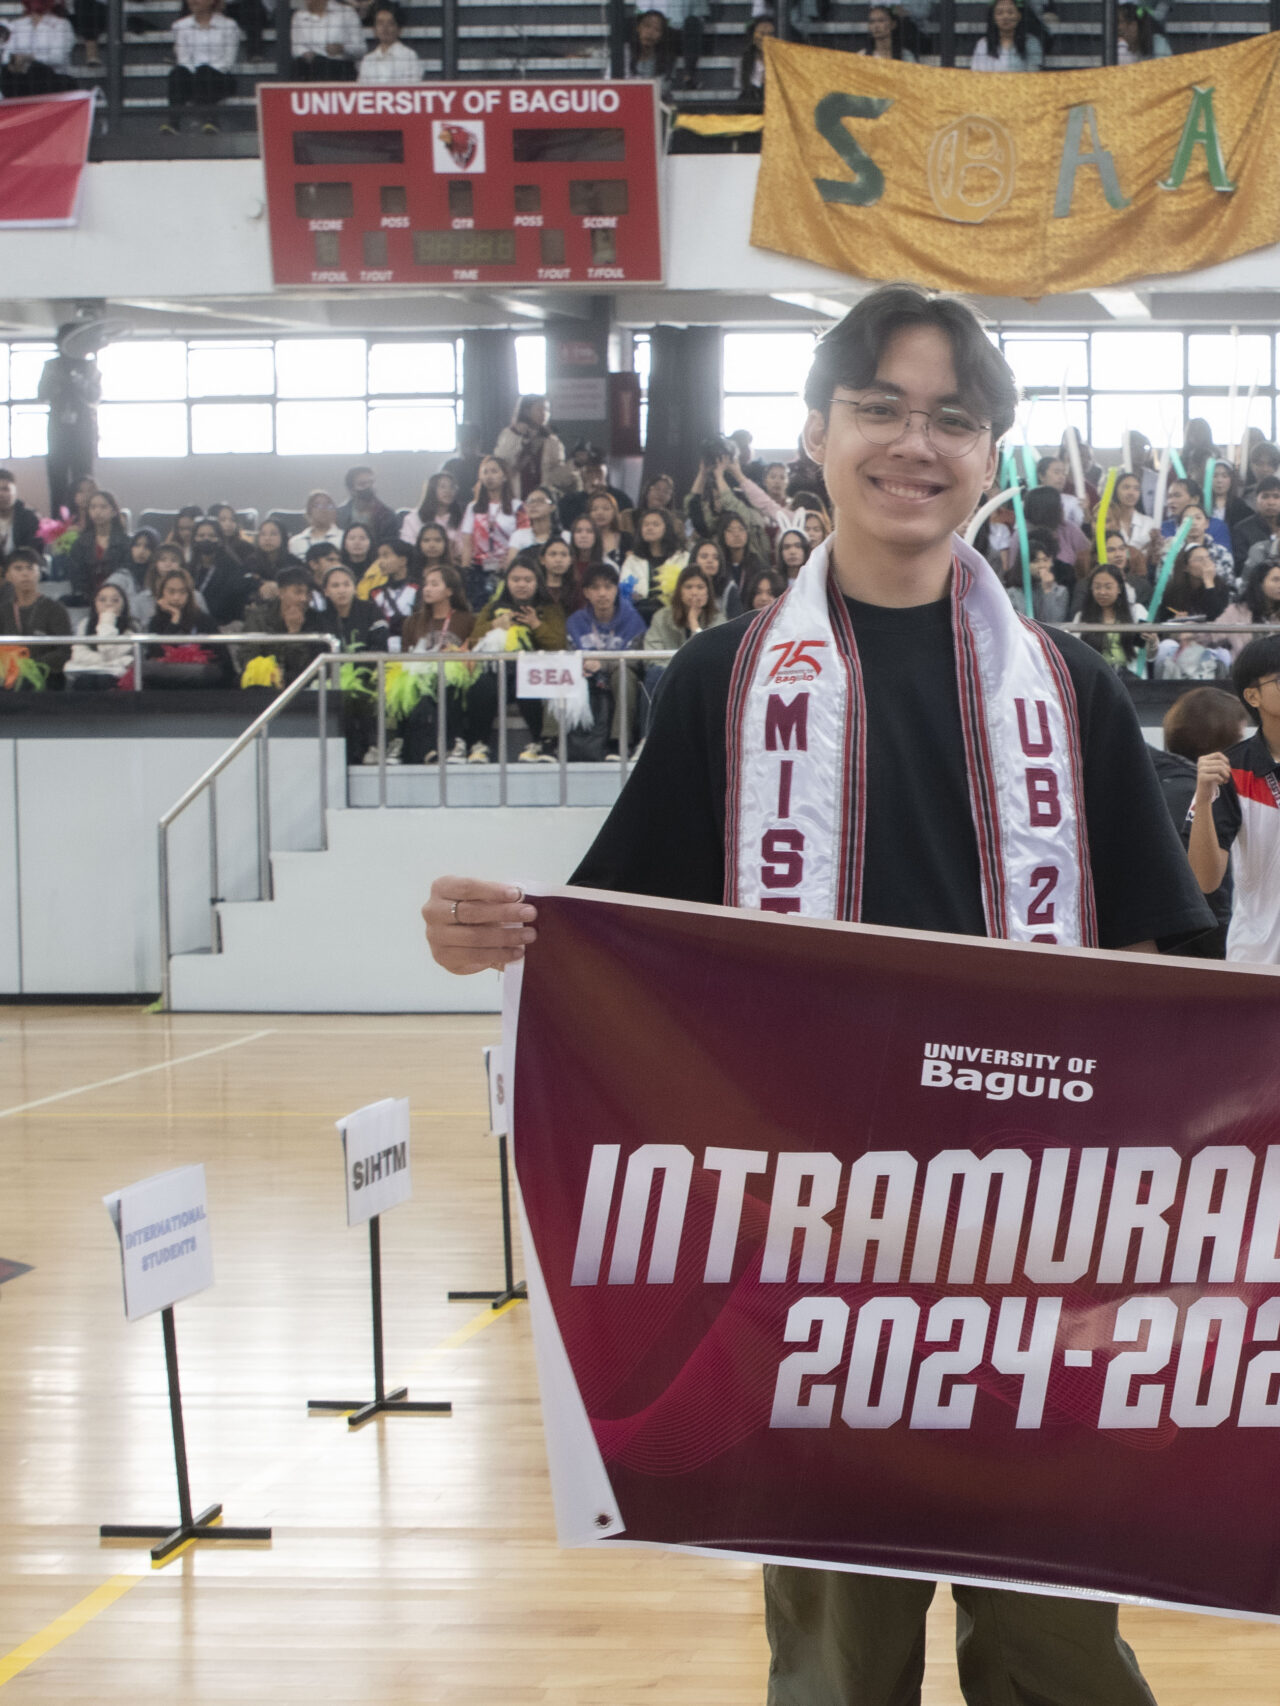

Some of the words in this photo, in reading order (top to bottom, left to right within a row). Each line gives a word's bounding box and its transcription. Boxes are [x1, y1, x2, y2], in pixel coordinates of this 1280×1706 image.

[291, 91, 456, 115] UNIVERSITY
[463, 90, 501, 114] OF
[510, 89, 620, 113] BAGUIO
[309, 219, 343, 231] SCORE
[381, 217, 410, 228] POSS
[514, 215, 544, 227] POSS
[582, 216, 618, 229] SCORE
[453, 269, 479, 281] TIME
[528, 668, 575, 686] SEA
[766, 640, 829, 686] 75
[1014, 698, 1062, 828] UB
[1027, 866, 1060, 944] 2
[924, 1043, 1061, 1070] UNIVERSITY
[1067, 1057, 1097, 1074] OF
[921, 1059, 1094, 1102] Baguio
[352, 1141, 407, 1192] SIHTM
[125, 1204, 207, 1251] INTERNATIONAL
[142, 1236, 197, 1272] STUDENTS
